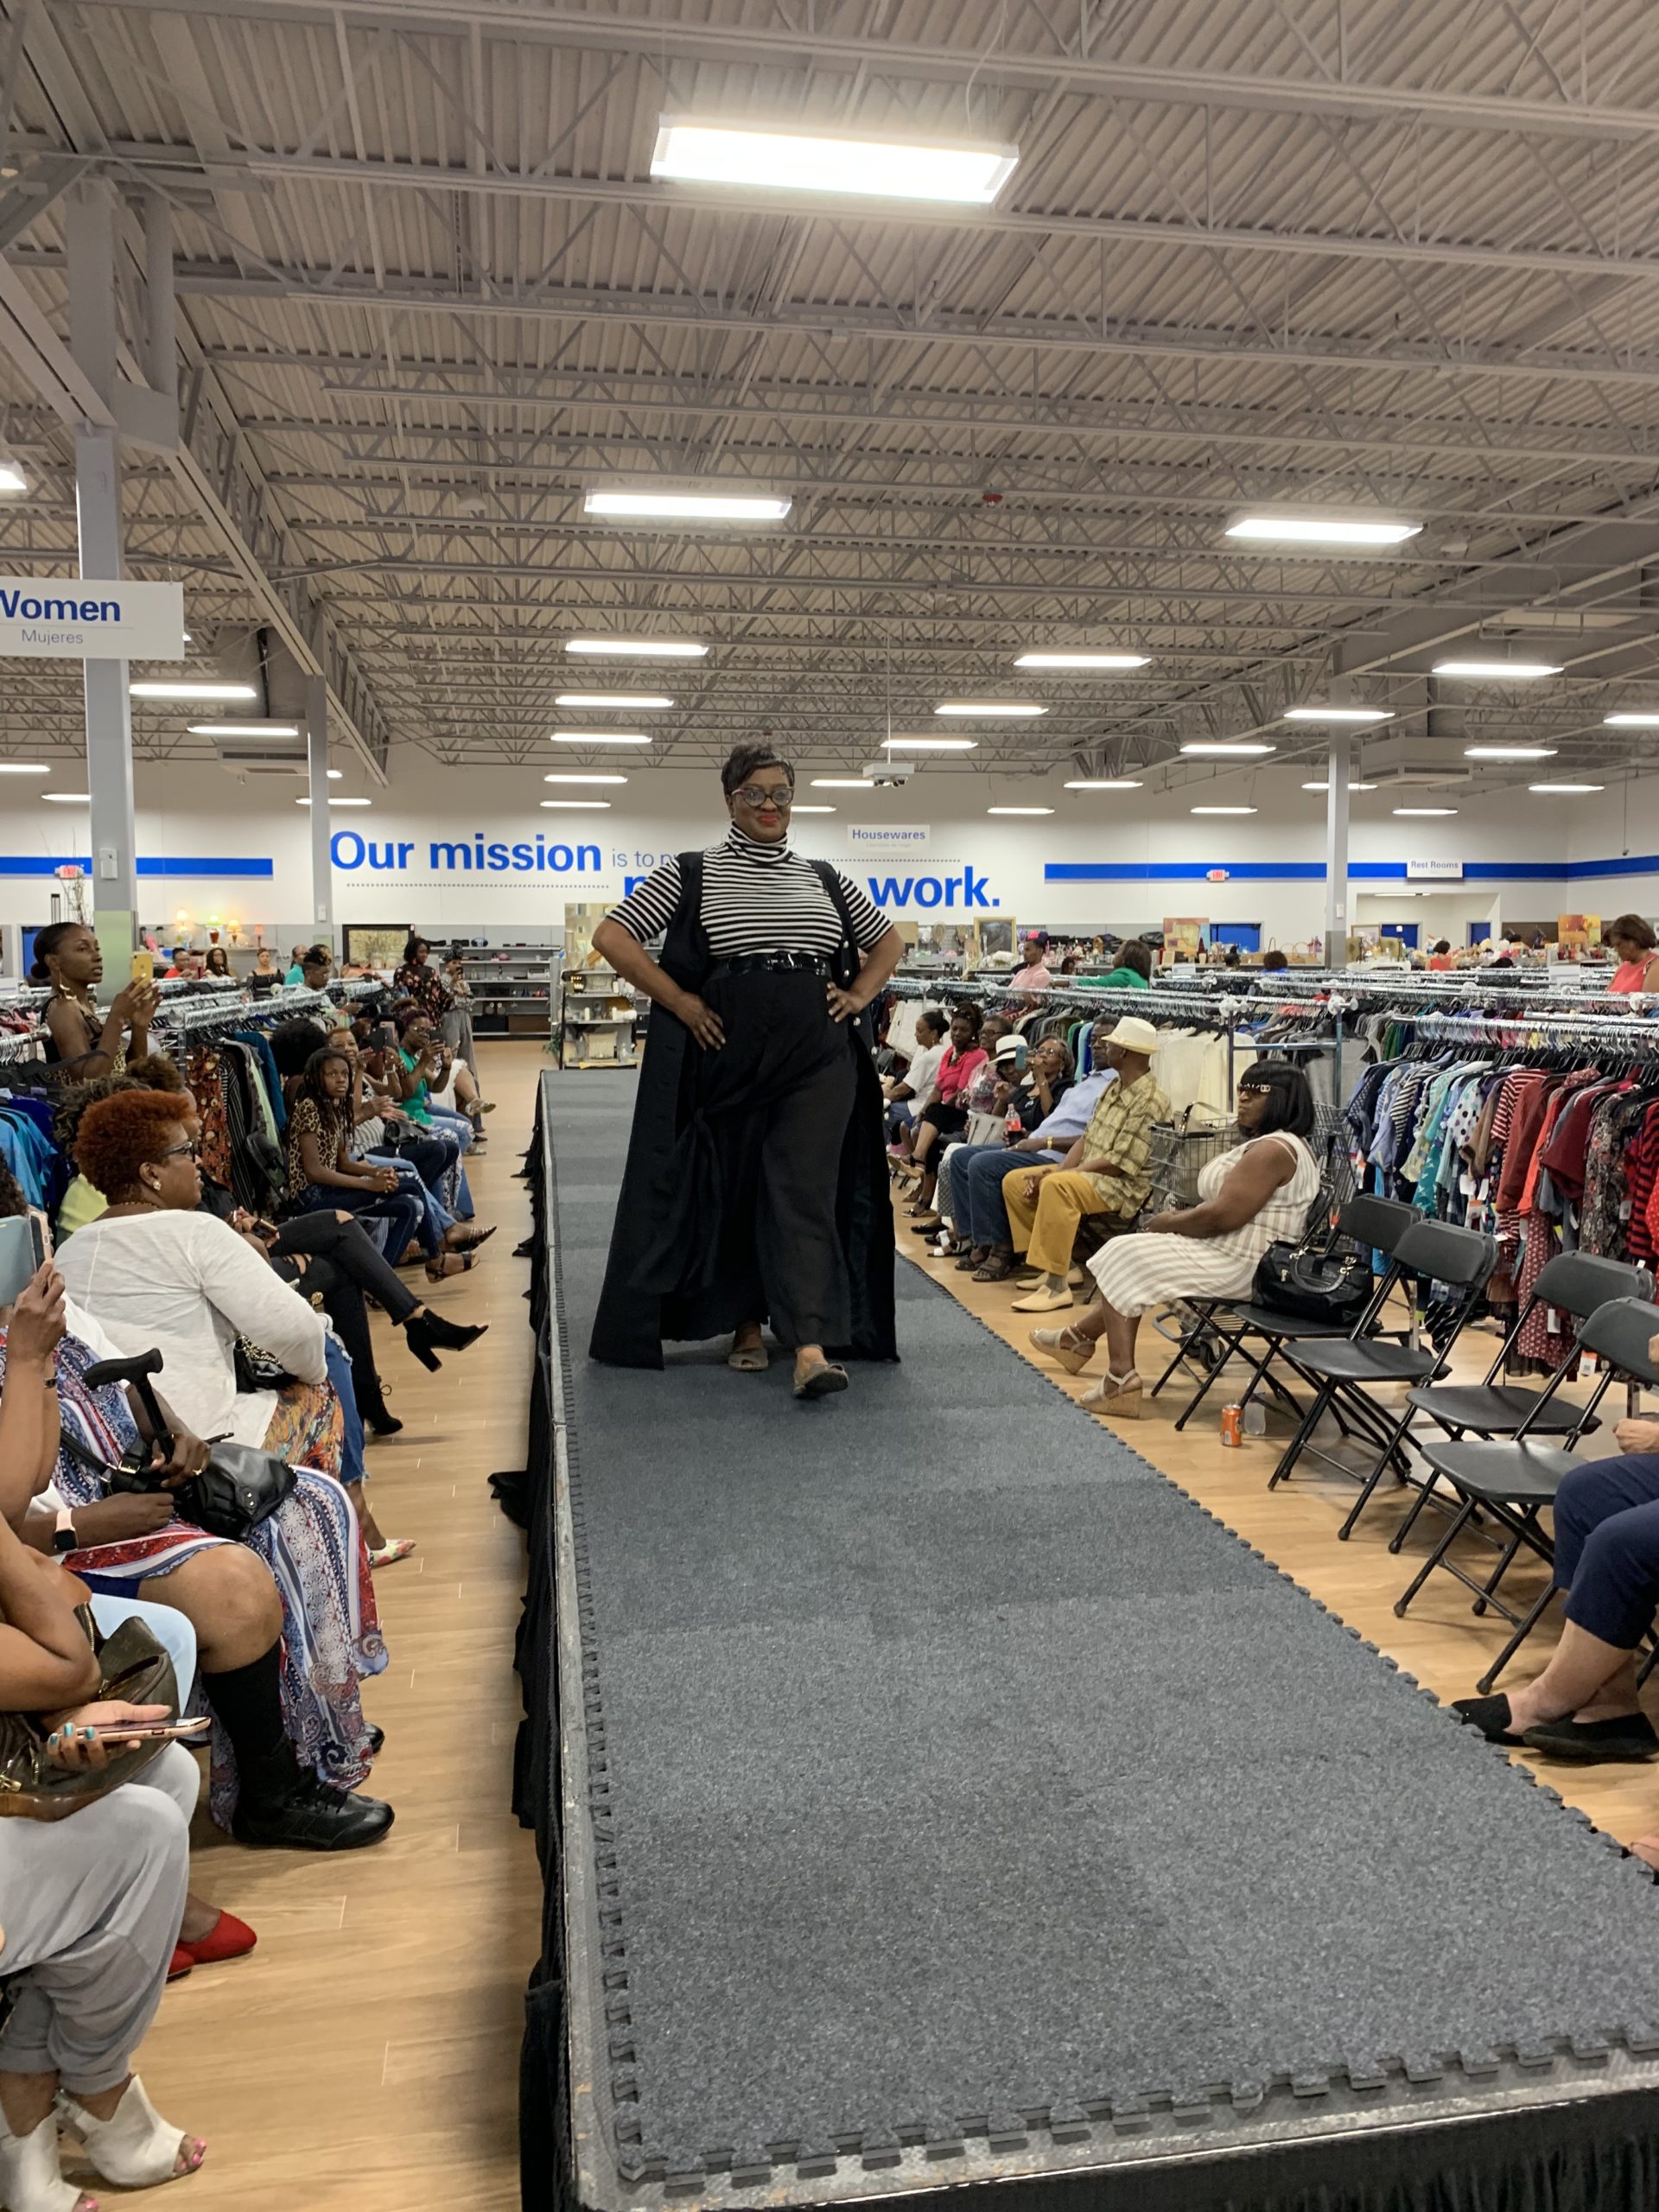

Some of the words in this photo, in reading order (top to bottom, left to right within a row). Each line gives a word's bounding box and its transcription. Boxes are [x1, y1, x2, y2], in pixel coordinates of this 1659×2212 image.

[22, 628, 84, 645] Mujeres
[852, 829, 926, 840] Housewares
[329, 830, 414, 870] Our
[429, 833, 601, 872] mission
[612, 848, 628, 868] is
[634, 850, 655, 868] to
[1430, 861, 1459, 869] Rooms
[868, 865, 1000, 907] work.
